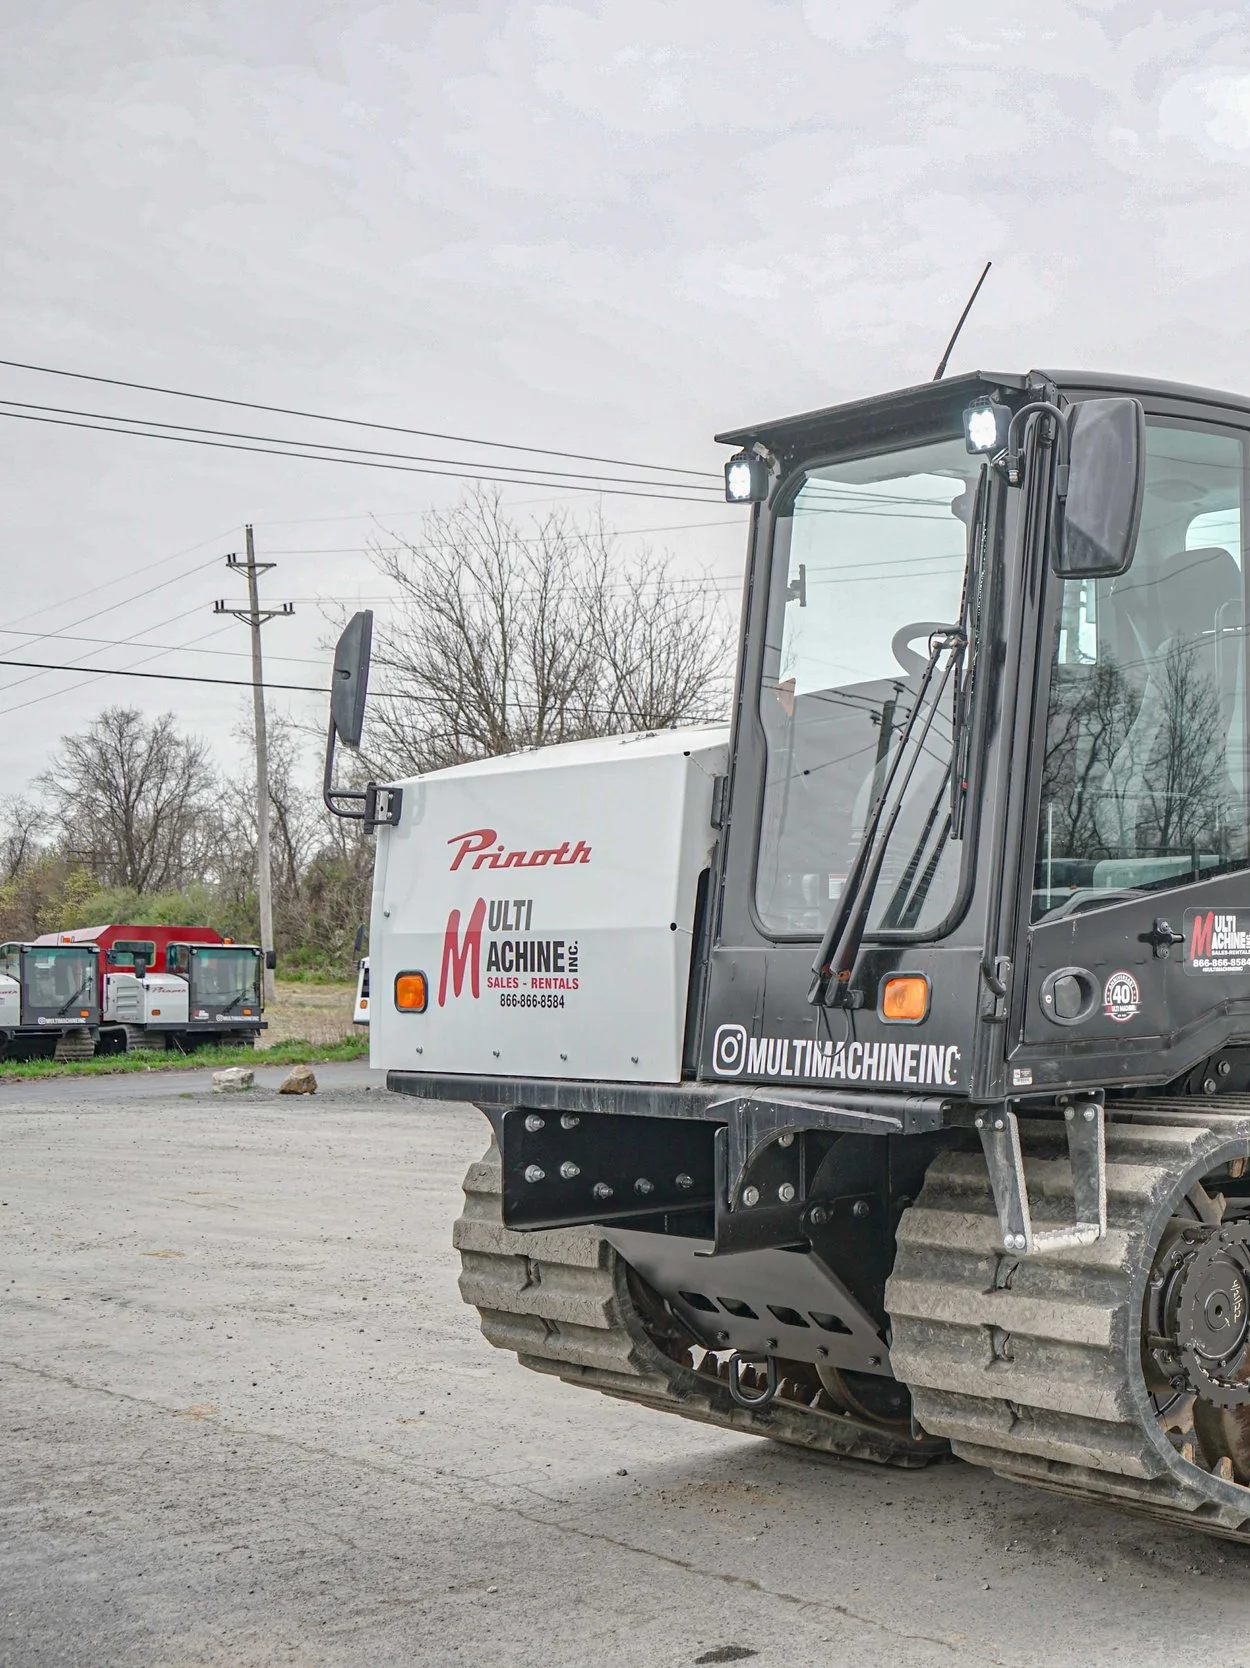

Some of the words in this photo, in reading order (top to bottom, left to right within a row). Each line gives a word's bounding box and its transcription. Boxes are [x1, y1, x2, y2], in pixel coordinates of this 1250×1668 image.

[447, 828, 593, 871] Prinoth
[568, 940, 579, 973] INC.
[487, 977, 520, 989] SALES
[531, 977, 579, 990] RENTALS
[1112, 984, 1131, 1004] 40
[500, 993, 565, 1009] 866-866-8584
[747, 1037, 962, 1086] MULTIMACHINEINC
